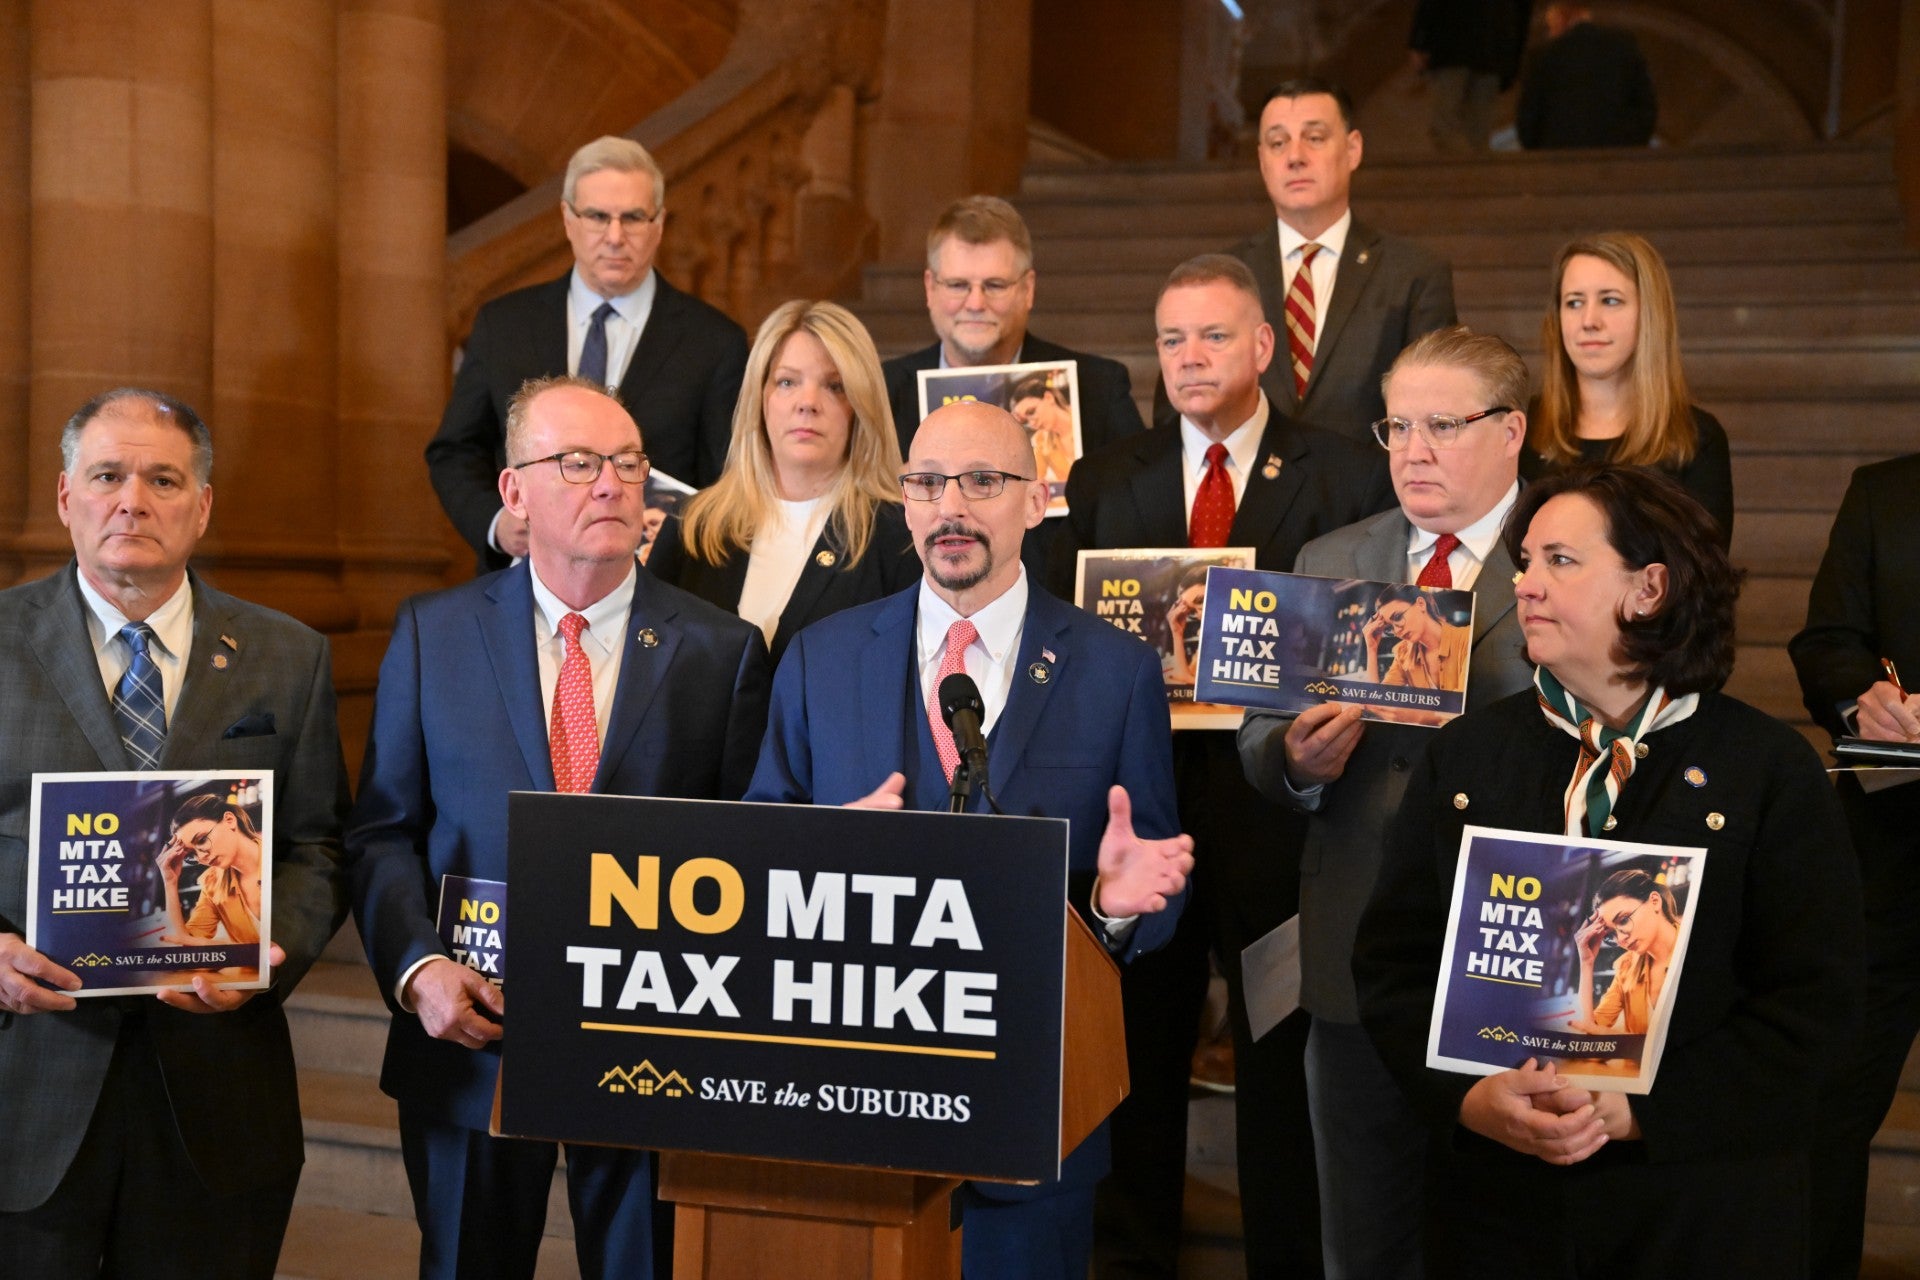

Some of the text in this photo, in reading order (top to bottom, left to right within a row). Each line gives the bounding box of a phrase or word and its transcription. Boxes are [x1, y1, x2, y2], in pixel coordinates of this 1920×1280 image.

[1102, 579, 1141, 598] NO
[1229, 588, 1278, 613] NO
[1096, 599, 1145, 615] MTA
[1103, 617, 1142, 633] AX
[1221, 613, 1280, 637] MTA
[1221, 636, 1276, 660] TAX
[1212, 659, 1281, 684] HIKE
[1341, 687, 1441, 706] SAVE the SUBURBS
[66, 813, 120, 836] NO
[59, 840, 125, 860] MTA
[60, 864, 122, 884] TAX
[52, 888, 129, 909] HIKE
[1489, 873, 1542, 902] NO
[460, 898, 500, 925] NO
[589, 852, 983, 950] NO MTA
[1480, 901, 1544, 929] MTA
[452, 924, 503, 950] MTA
[1479, 927, 1540, 955] TAX
[115, 951, 227, 966] SAVE the SUBURBS
[452, 948, 499, 973] TAX
[1467, 951, 1544, 982] HIKE
[566, 945, 997, 1037] TAX HIKE
[1522, 1035, 1618, 1052] SAVE the SUBURBS
[699, 1077, 971, 1122] SAVE the SUBURBS
